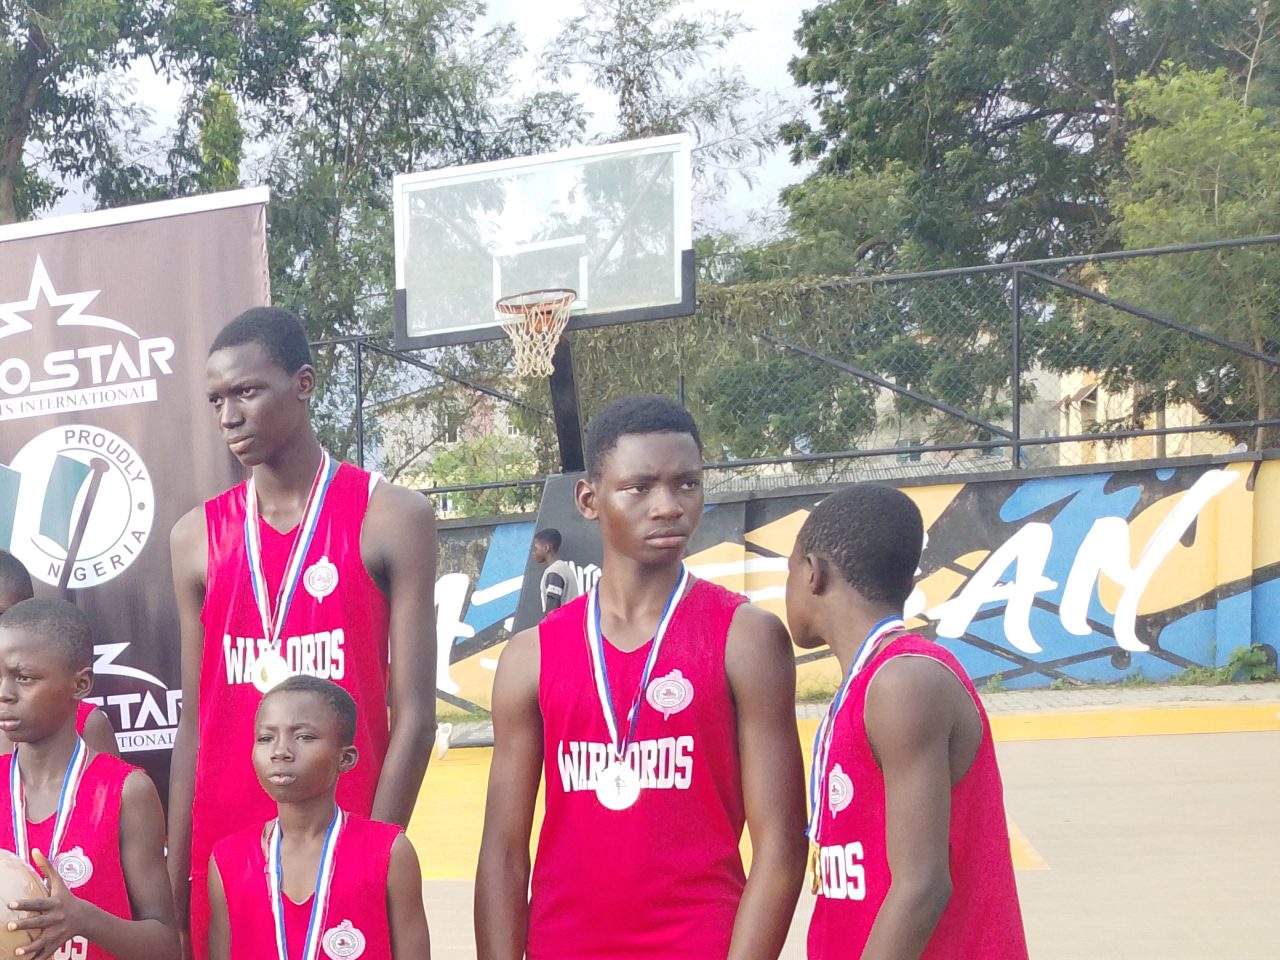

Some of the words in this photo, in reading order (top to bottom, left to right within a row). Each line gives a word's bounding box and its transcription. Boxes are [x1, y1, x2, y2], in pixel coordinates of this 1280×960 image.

[19, 385, 150, 414] INTERNATIONAL
[64, 429, 146, 484] PROUDLY
[47, 528, 147, 582] NGERIA
